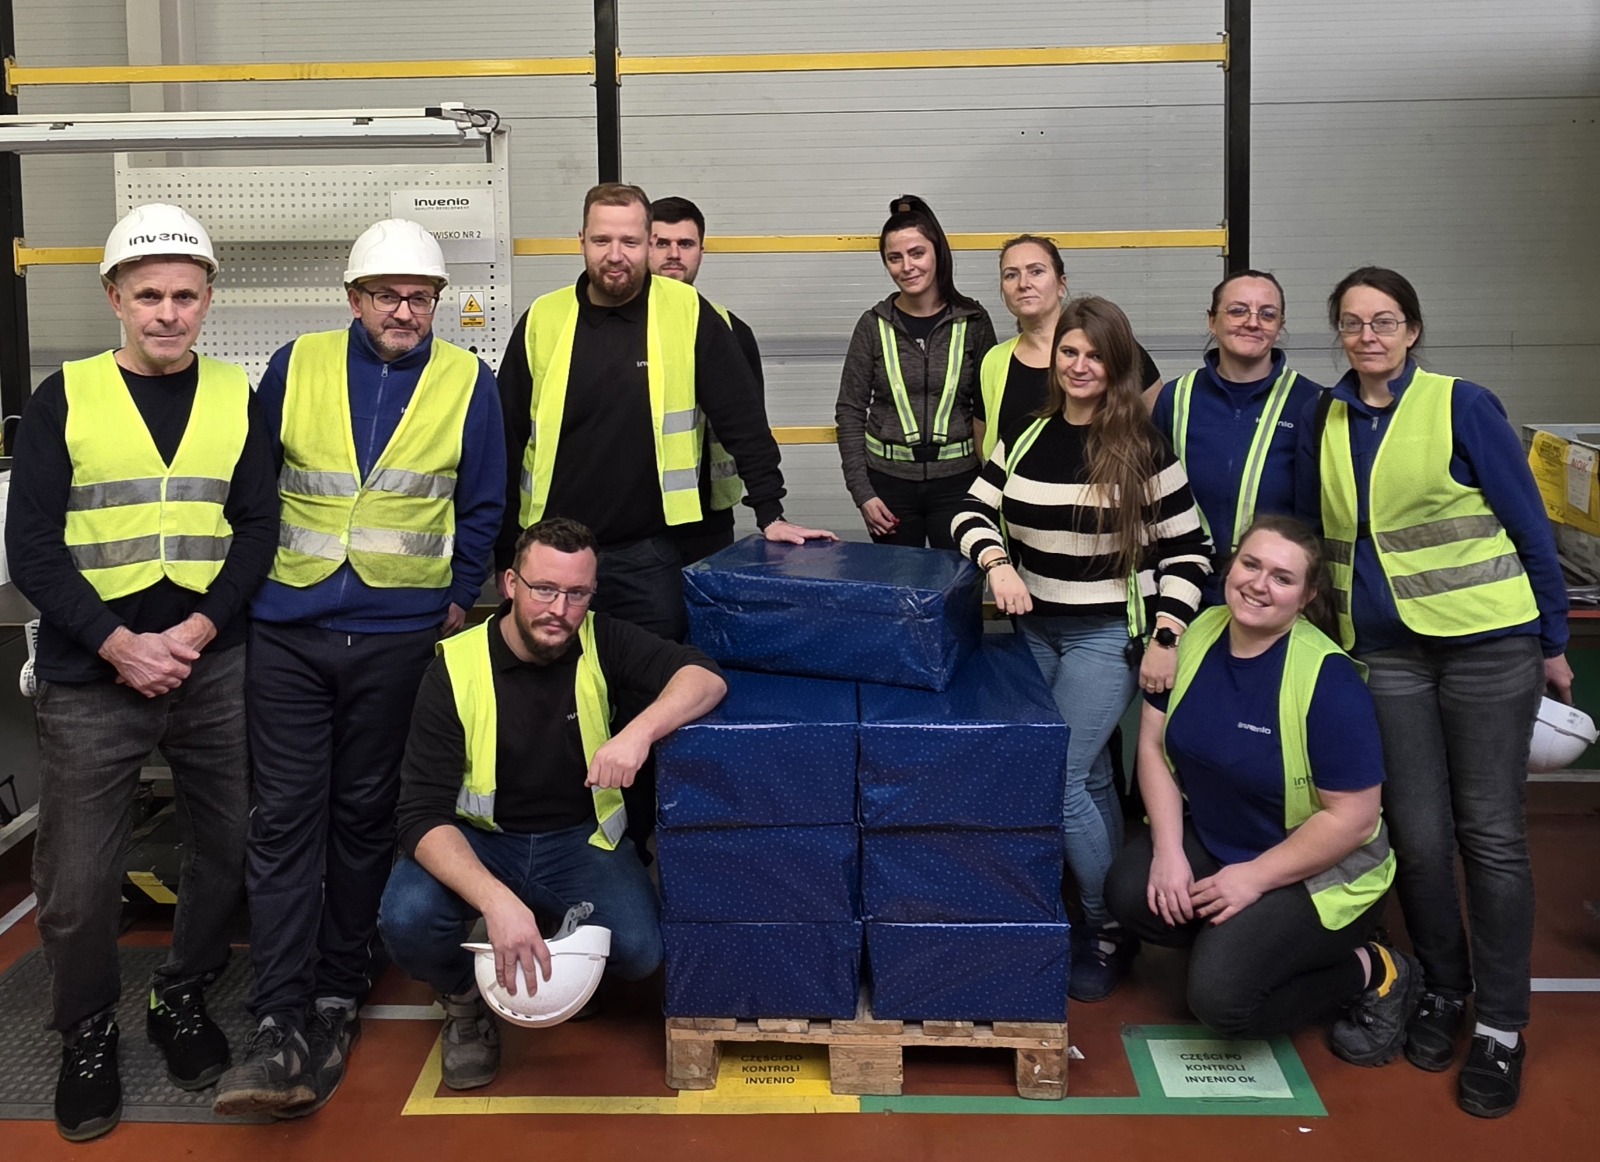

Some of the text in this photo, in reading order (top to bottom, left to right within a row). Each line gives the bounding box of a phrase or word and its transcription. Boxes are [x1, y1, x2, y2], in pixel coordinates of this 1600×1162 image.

[414, 198, 470, 207] invenio
[129, 233, 199, 246] invenio
[463, 231, 474, 239] NR
[476, 231, 482, 239] 2
[1570, 458, 1589, 472] NOK
[1237, 722, 1271, 735] invenio
[1180, 1052, 1223, 1061] CZĘŚCI
[742, 1065, 800, 1073] KONTROLI
